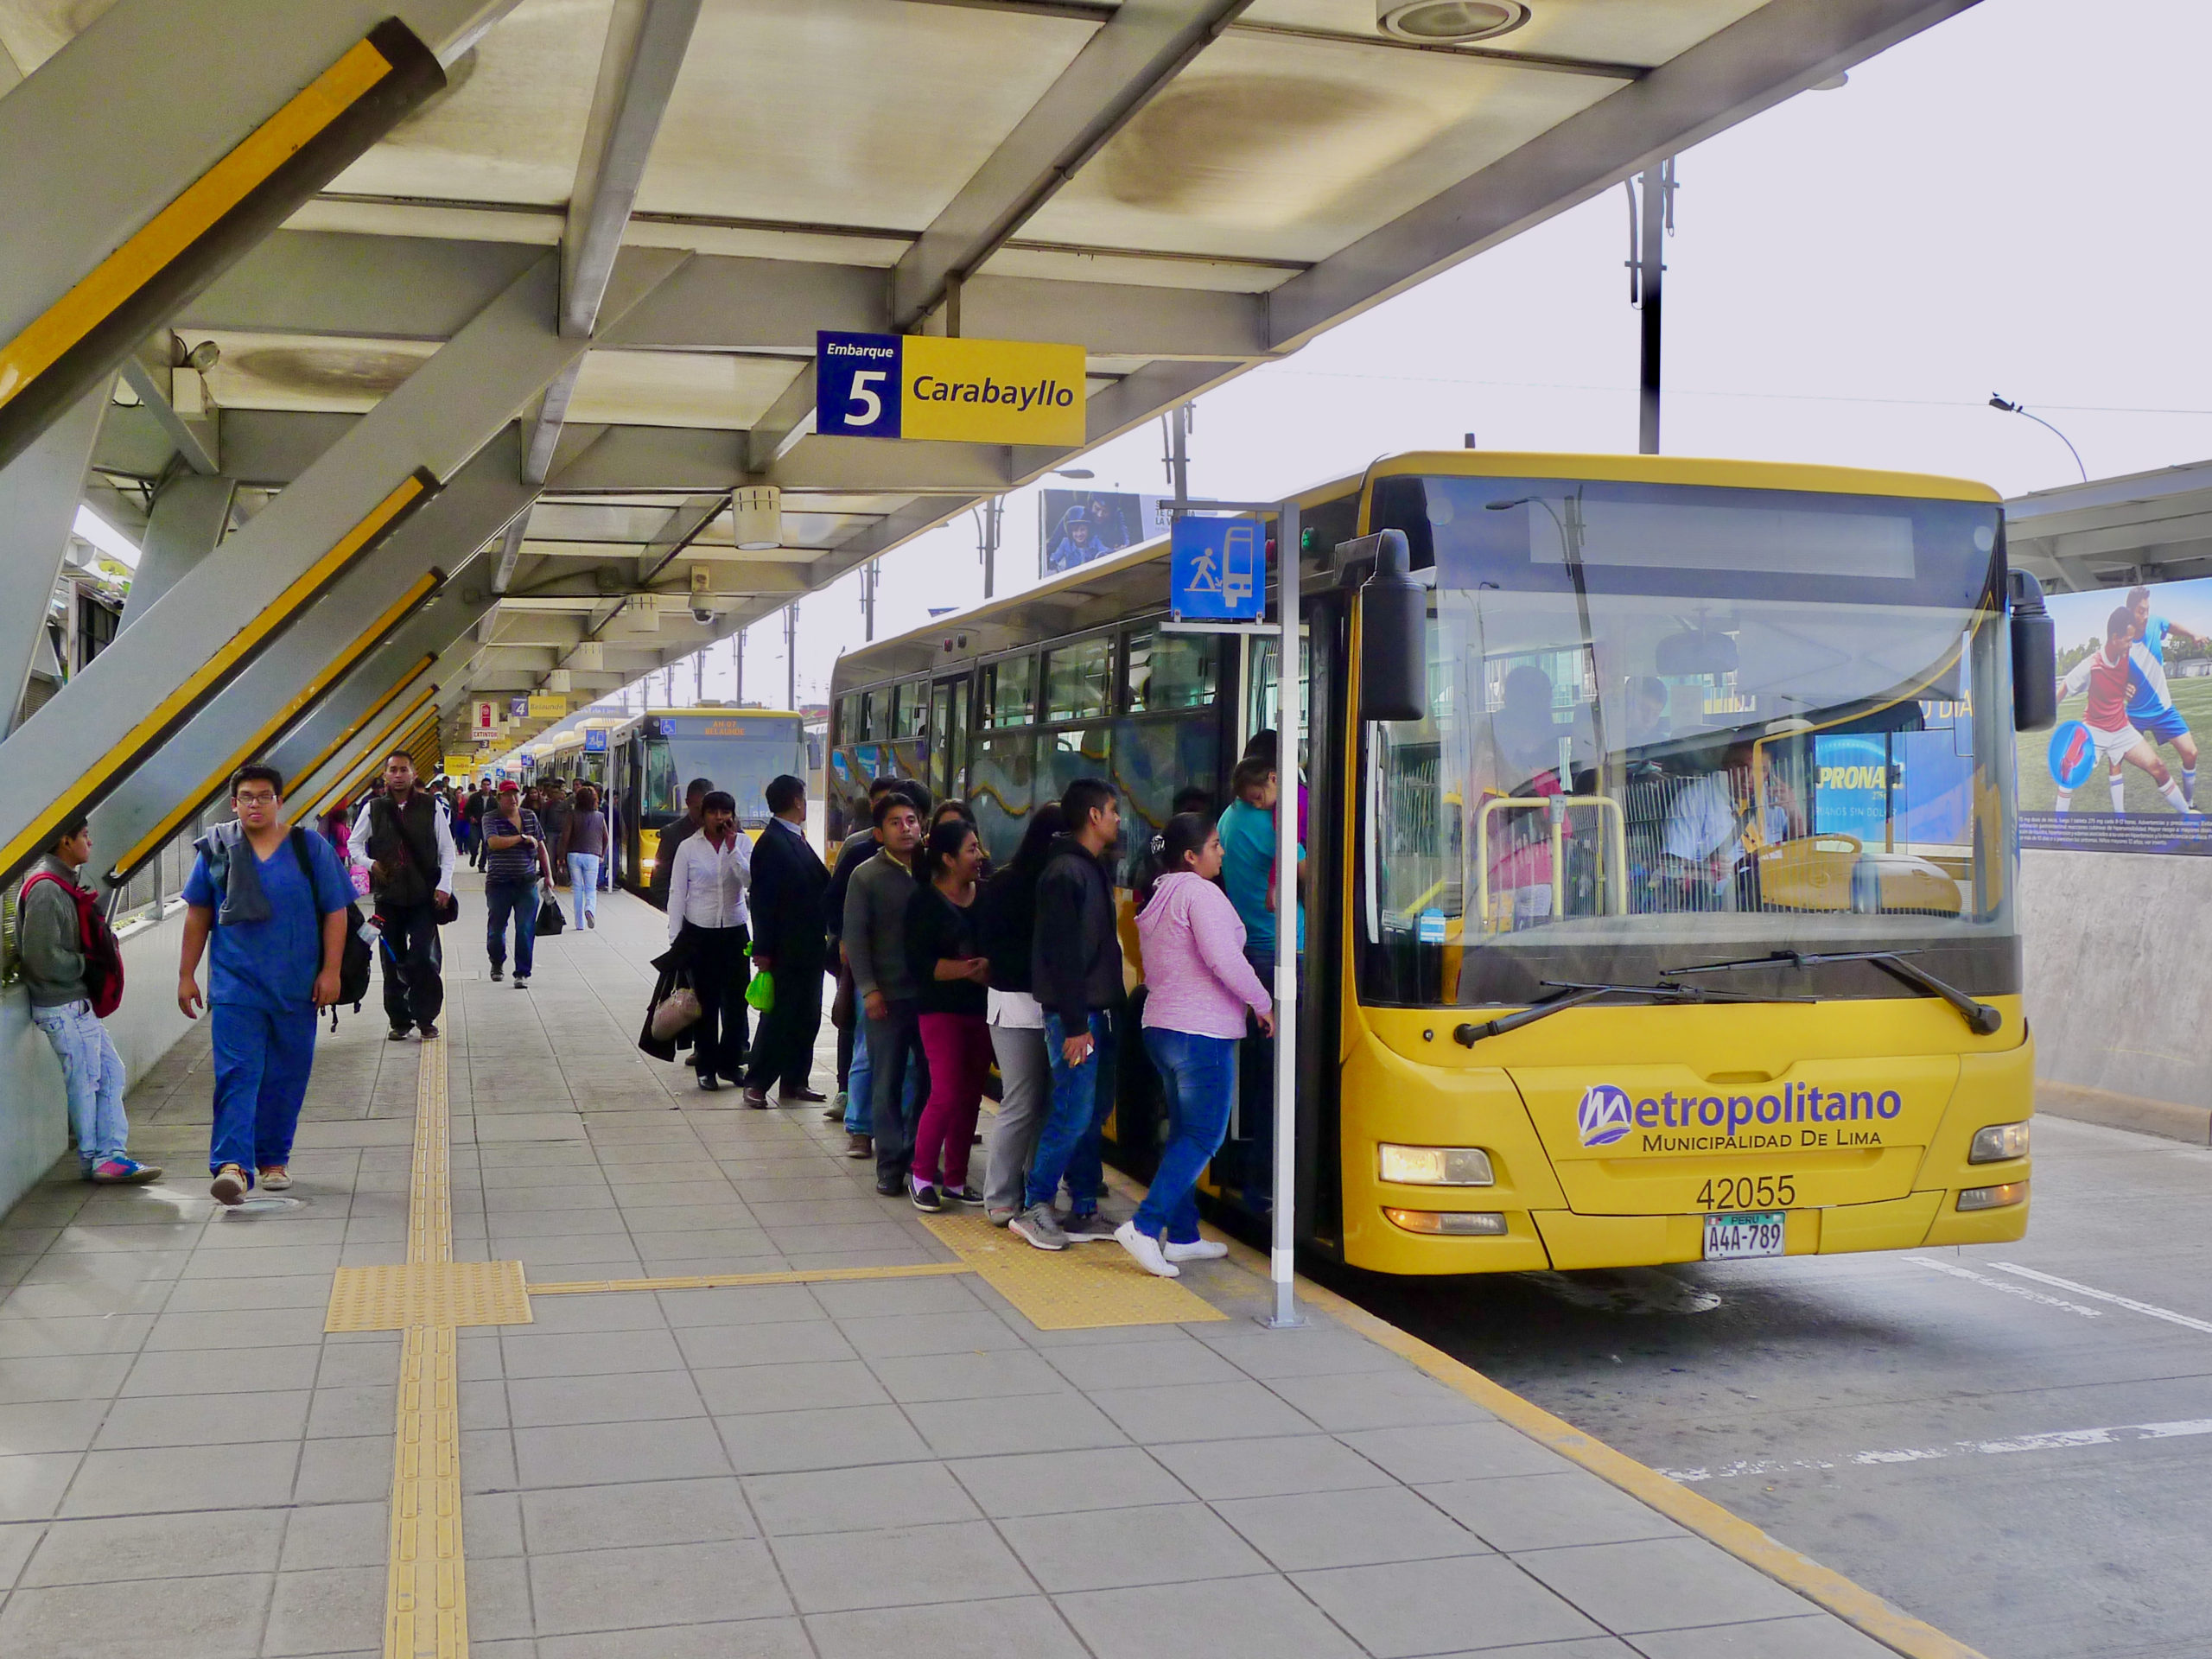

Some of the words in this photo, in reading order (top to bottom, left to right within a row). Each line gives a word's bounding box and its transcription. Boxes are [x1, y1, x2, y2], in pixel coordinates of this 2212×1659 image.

[826, 342, 894, 359] Embarque
[843, 370, 887, 426] 5
[912, 375, 1074, 411] Carabayllo
[516, 702, 525, 715] 4
[1578, 1081, 1902, 1147] Metropolitano
[1696, 1175, 1796, 1210] 42055
[1731, 1215, 1759, 1225] PERU
[1709, 1224, 1781, 1252] A4A-789
